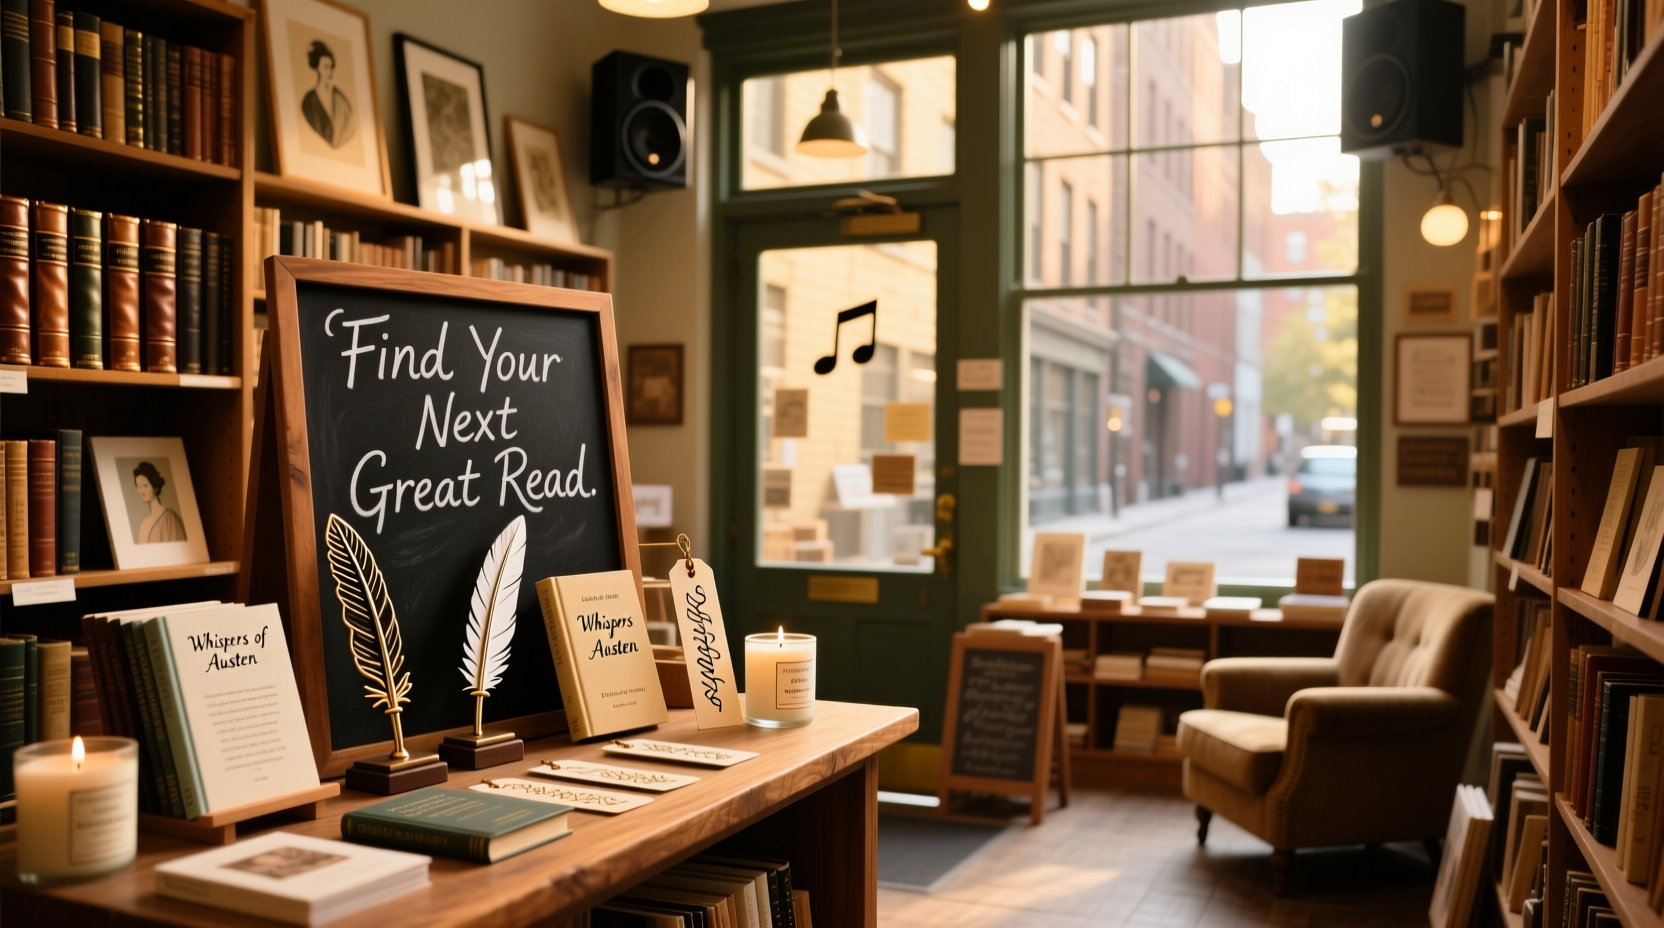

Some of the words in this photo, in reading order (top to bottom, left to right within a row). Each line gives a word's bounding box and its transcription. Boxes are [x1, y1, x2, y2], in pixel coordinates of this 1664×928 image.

[469, 323, 563, 393] Your
[415, 391, 518, 450] Next
[350, 449, 481, 534] Great
[494, 443, 597, 513] Read.
[187, 631, 249, 653] Whispers
[254, 625, 269, 648] of
[577, 612, 634, 639] Whispers
[205, 652, 258, 673] Austen
